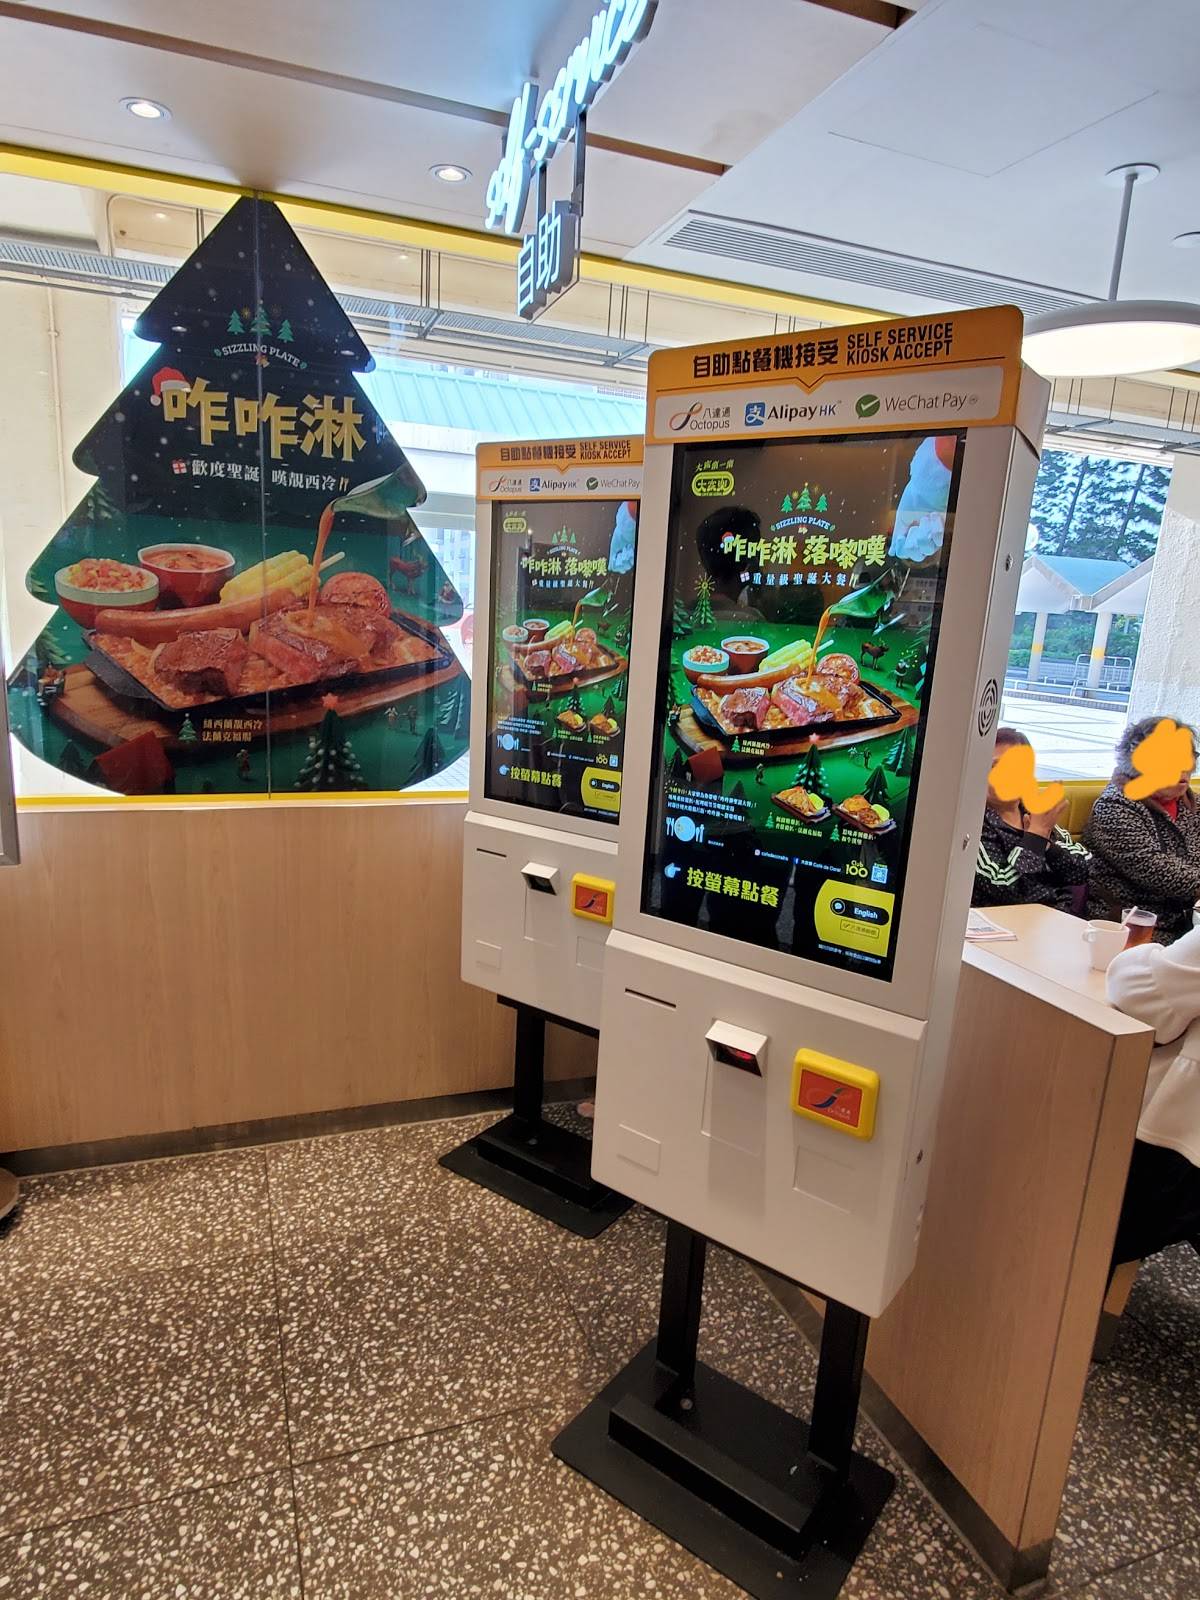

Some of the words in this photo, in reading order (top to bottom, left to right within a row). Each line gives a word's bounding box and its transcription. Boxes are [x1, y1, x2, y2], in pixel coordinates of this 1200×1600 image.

[517, 200, 562, 317] 自助
[847, 330, 882, 350] SELF
[887, 321, 954, 345] SERVICE
[221, 343, 268, 356] SIZZLING
[269, 346, 301, 368] PLATE
[693, 338, 839, 379] 自助點餐機接受
[846, 346, 889, 366] KIOSK
[893, 339, 953, 361] ACCEPT
[884, 393, 937, 412] WeChat
[940, 391, 968, 412] Pay
[162, 376, 367, 463] 咋咋淋
[689, 417, 730, 432] Octopus
[580, 450, 601, 460] KIOSK
[603, 449, 631, 459] ACCEPT
[191, 459, 260, 482] 歡度聖誕
[775, 516, 807, 530] SIZZLING
[808, 516, 831, 530] PLATE
[846, 864, 869, 878] 100
[687, 867, 779, 908] 按螢幕點餐
[853, 908, 879, 920] English
